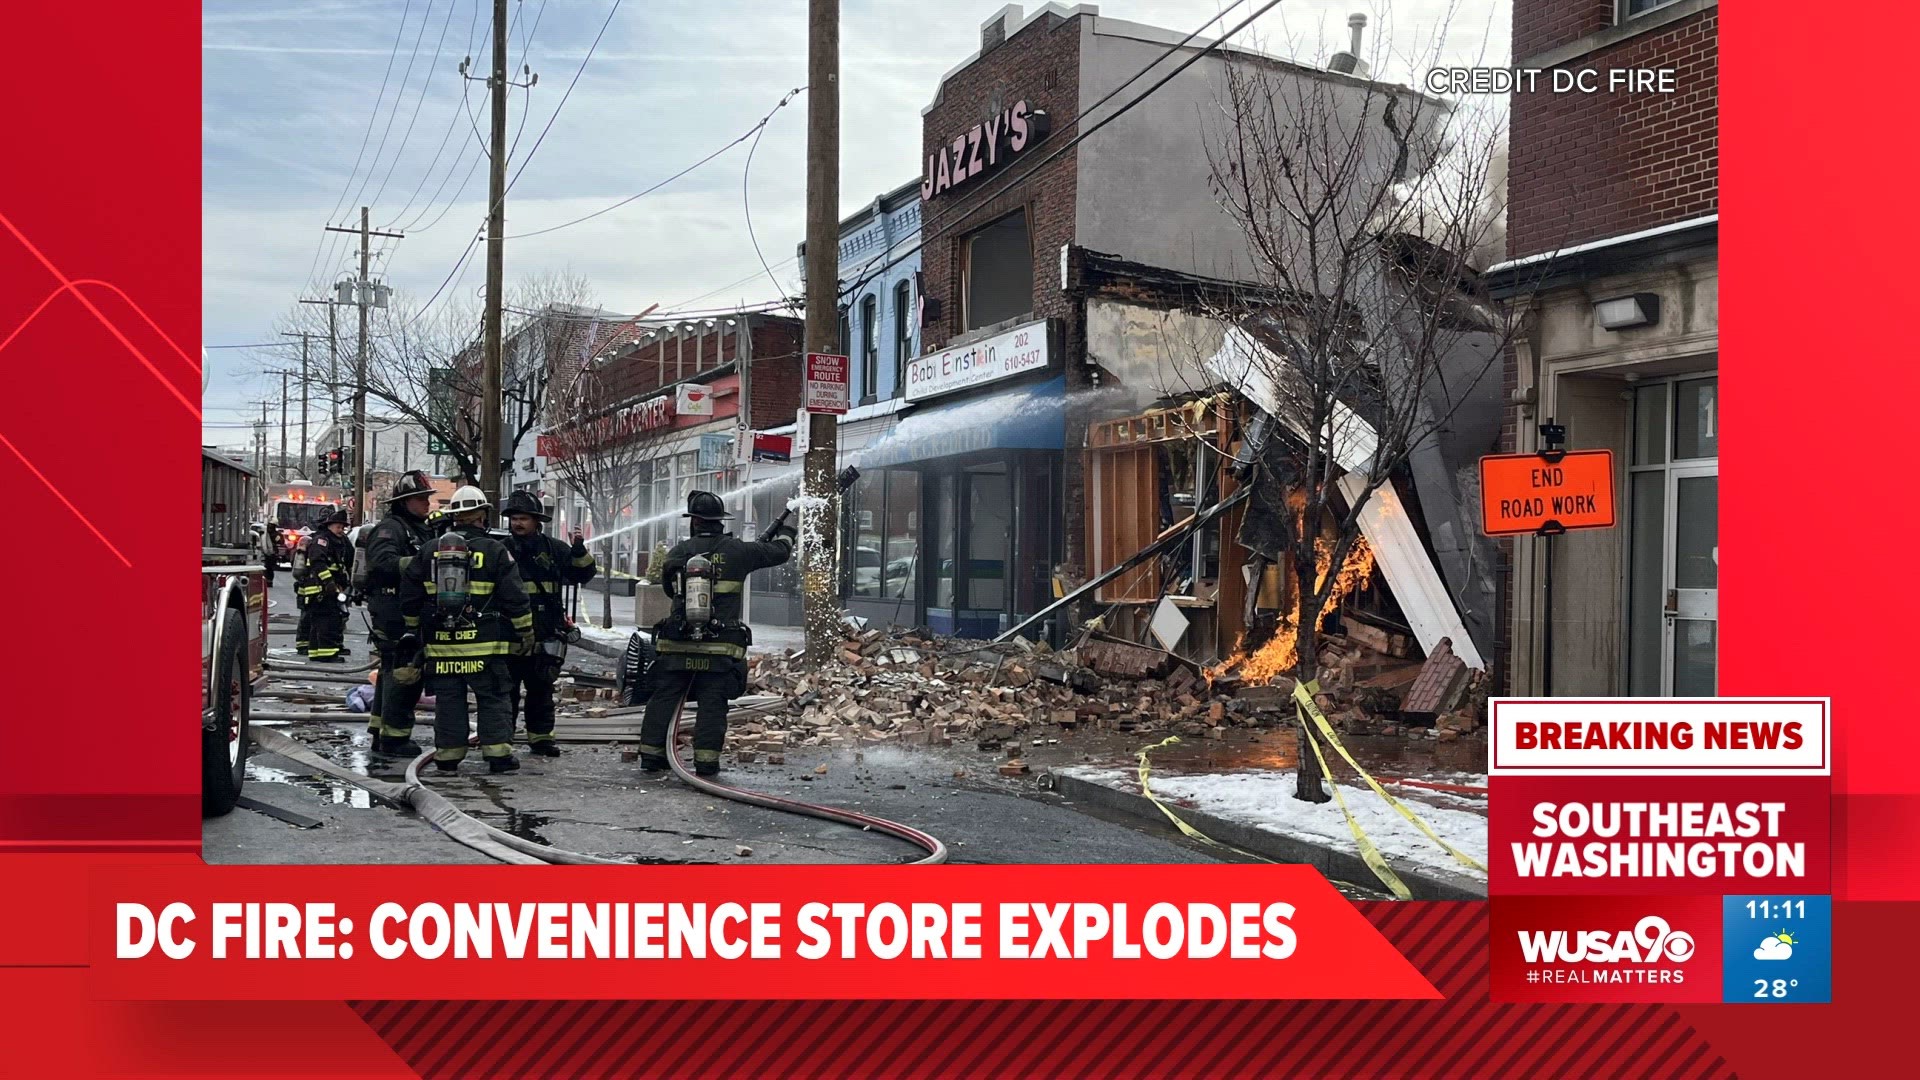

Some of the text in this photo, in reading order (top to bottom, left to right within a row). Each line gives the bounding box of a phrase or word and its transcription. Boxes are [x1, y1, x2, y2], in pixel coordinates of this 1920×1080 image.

[920, 99, 1029, 201] JAZZY'S
[1014, 332, 1029, 348] 202
[815, 355, 840, 366] SNOW
[1004, 350, 1040, 371] 610-5437
[811, 364, 843, 373] EMERGENCY
[911, 363, 937, 384] Babi
[814, 371, 841, 381] ROUTE
[929, 377, 970, 393] Development
[971, 370, 994, 382] Center
[809, 382, 845, 391] NO PARKING
[816, 390, 838, 399] DURING
[809, 399, 844, 408] EMERGENCY
[631, 395, 668, 433] CENTER
[1531, 468, 1563, 488] END
[1501, 495, 1596, 518] ROAD WORK
[435, 630, 478, 640] FIRE CHIEF
[436, 661, 484, 674] HUTCHINS
